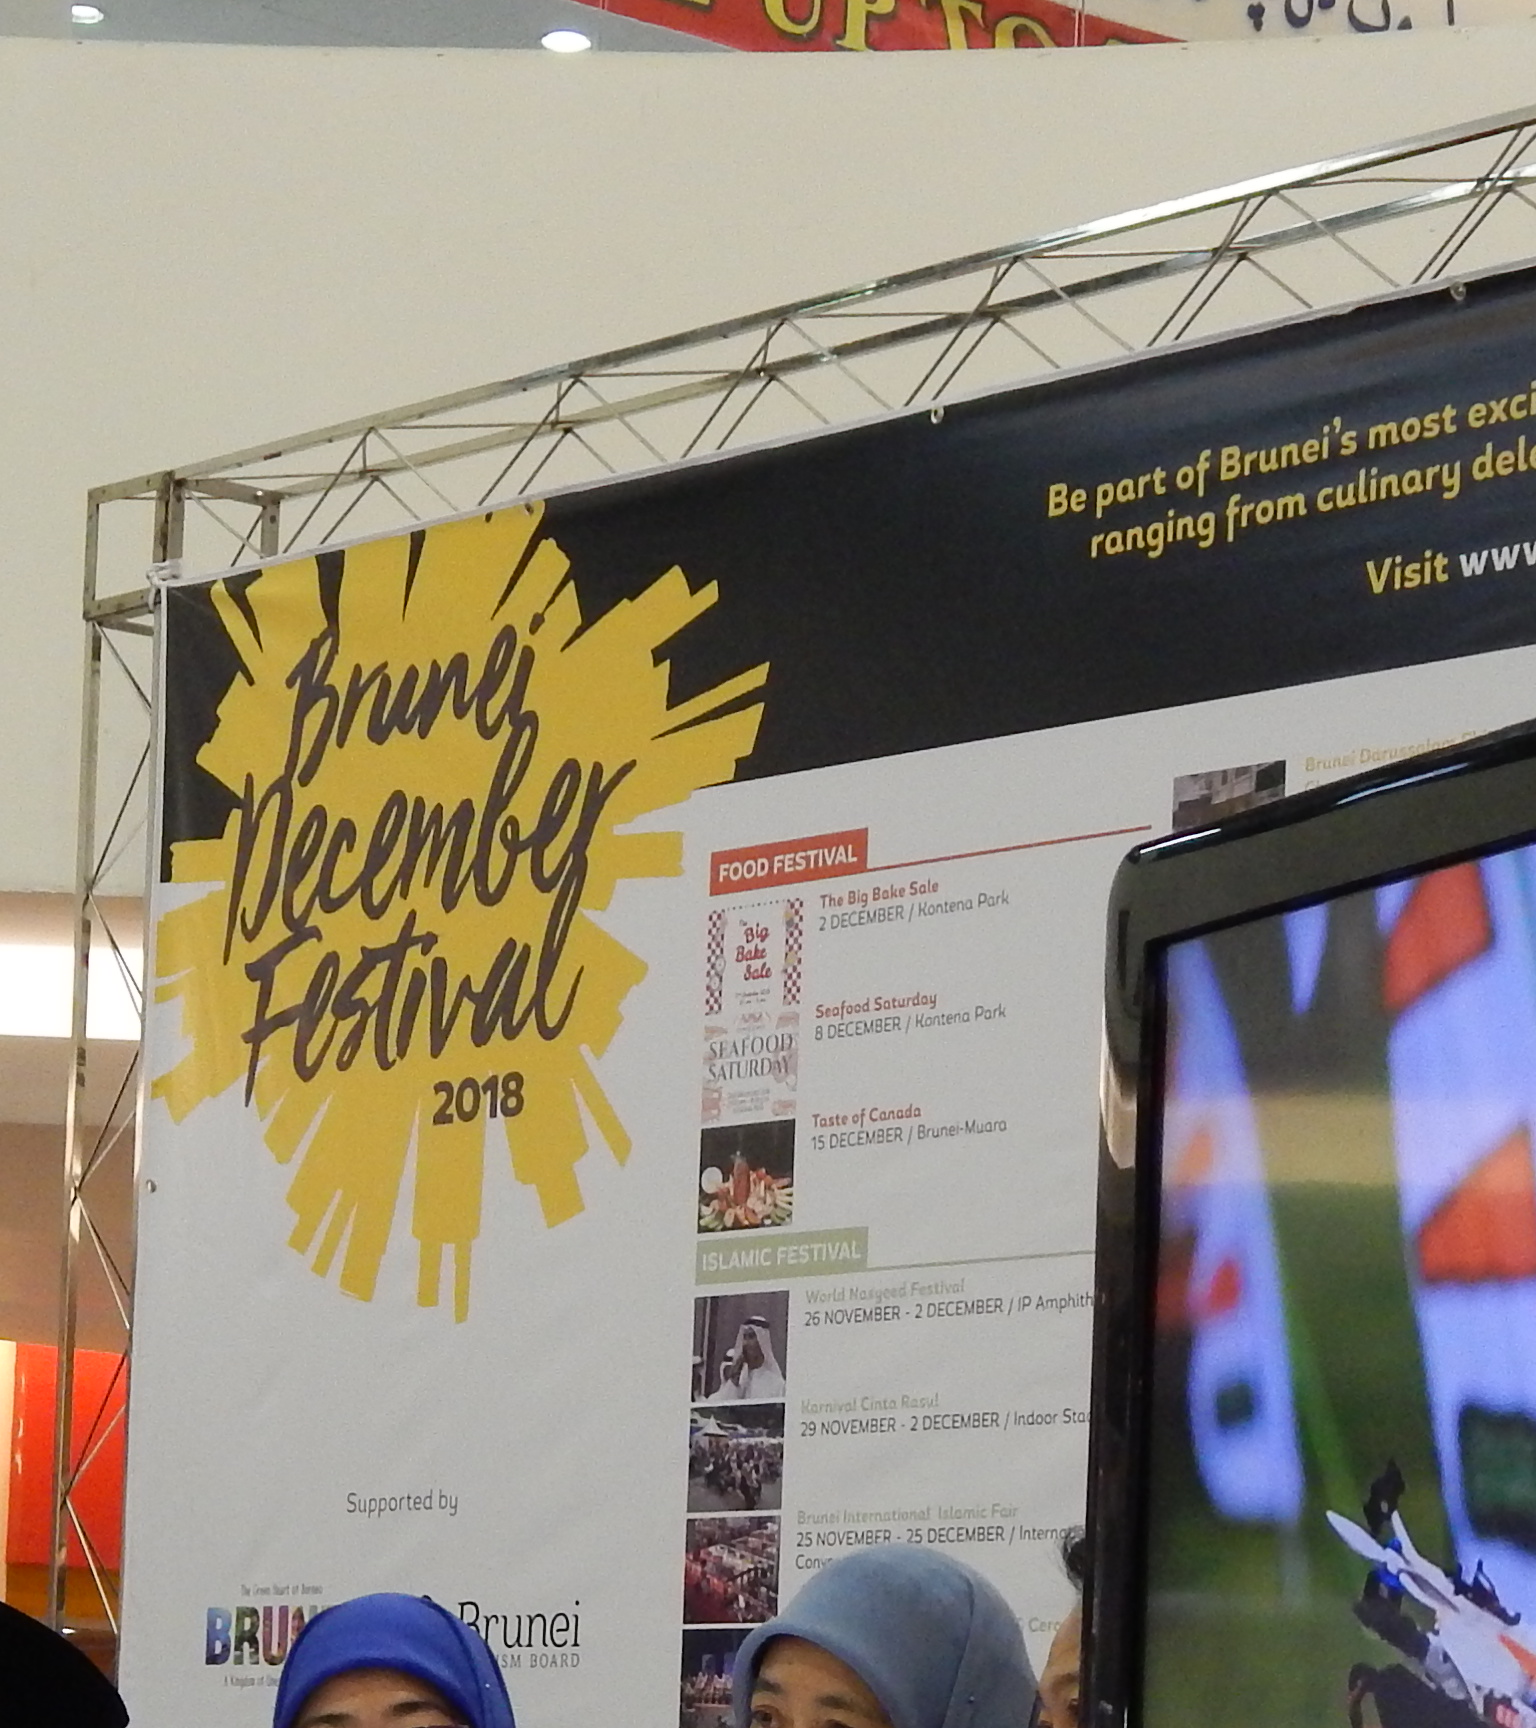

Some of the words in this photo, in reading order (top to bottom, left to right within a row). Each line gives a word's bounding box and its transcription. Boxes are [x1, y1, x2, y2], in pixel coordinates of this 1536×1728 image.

[1047, 483, 1087, 518] Be
[1096, 466, 1167, 519] part
[1176, 449, 1211, 498] of
[1368, 403, 1458, 450] most
[1090, 510, 1216, 559] ranging
[1226, 494, 1307, 542] from
[1317, 461, 1461, 513] culinary
[1366, 549, 1451, 595] Visit
[284, 611, 546, 790] Brunei
[222, 711, 637, 966] December
[718, 859, 769, 882] FOOD
[773, 844, 858, 875] FESTIVAL
[819, 893, 844, 908] The
[848, 889, 869, 909] Big
[873, 884, 906, 901] Bake
[909, 878, 939, 896] Sale
[819, 916, 826, 931] 2
[830, 904, 904, 930] DECEMBER
[908, 903, 914, 922] /
[918, 899, 973, 917] Kontena
[977, 890, 1010, 908] Park
[744, 922, 770, 943] Big
[735, 943, 768, 962] Bake
[240, 850, 584, 1108] Festival
[743, 961, 773, 981] Sale
[815, 998, 870, 1019] Seafood
[874, 992, 938, 1012] Saturday
[815, 1025, 823, 1041] 8
[827, 1016, 902, 1039] DECEMBER
[905, 1015, 912, 1034] /
[915, 1012, 970, 1028] Kontena
[974, 1003, 1007, 1021] Park
[709, 1033, 793, 1059] SEAFOOD
[708, 1056, 791, 1082] SATURDAY
[432, 1071, 525, 1126] 2018
[812, 1112, 848, 1129] Taste
[852, 1109, 866, 1128] of
[869, 1103, 921, 1123] Canada
[811, 1135, 824, 1151] 15
[829, 1129, 903, 1149] DECEMBER
[907, 1125, 913, 1146] /
[917, 1118, 1008, 1140] Brunei-Muara
[702, 1248, 772, 1272] ISLAMIC
[776, 1240, 861, 1266] FESTIVAL
[910, 1277, 966, 1298] Festival
[805, 1310, 821, 1327] 26
[824, 1305, 901, 1325] NOVEMBER
[915, 1303, 922, 1319] 2
[926, 1298, 1004, 1318] DECEMBER
[1007, 1297, 1014, 1316] /
[1017, 1295, 1031, 1311] IP
[800, 1420, 817, 1437] 29
[820, 1416, 896, 1435] NOVEMBER
[910, 1416, 918, 1432] 2
[922, 1411, 1000, 1431] DECEMBER
[1003, 1411, 1011, 1430] /
[1013, 1410, 1059, 1426] Indoor
[347, 1488, 433, 1519] Supported
[438, 1488, 458, 1517] by
[796, 1532, 813, 1547] 25
[816, 1529, 892, 1546] NOVEMBER
[906, 1528, 923, 1544] 25
[927, 1526, 1005, 1544] DECEMBER
[1008, 1525, 1016, 1546] /
[458, 1599, 581, 1649] Brunei
[530, 1653, 581, 1669] BOARD
